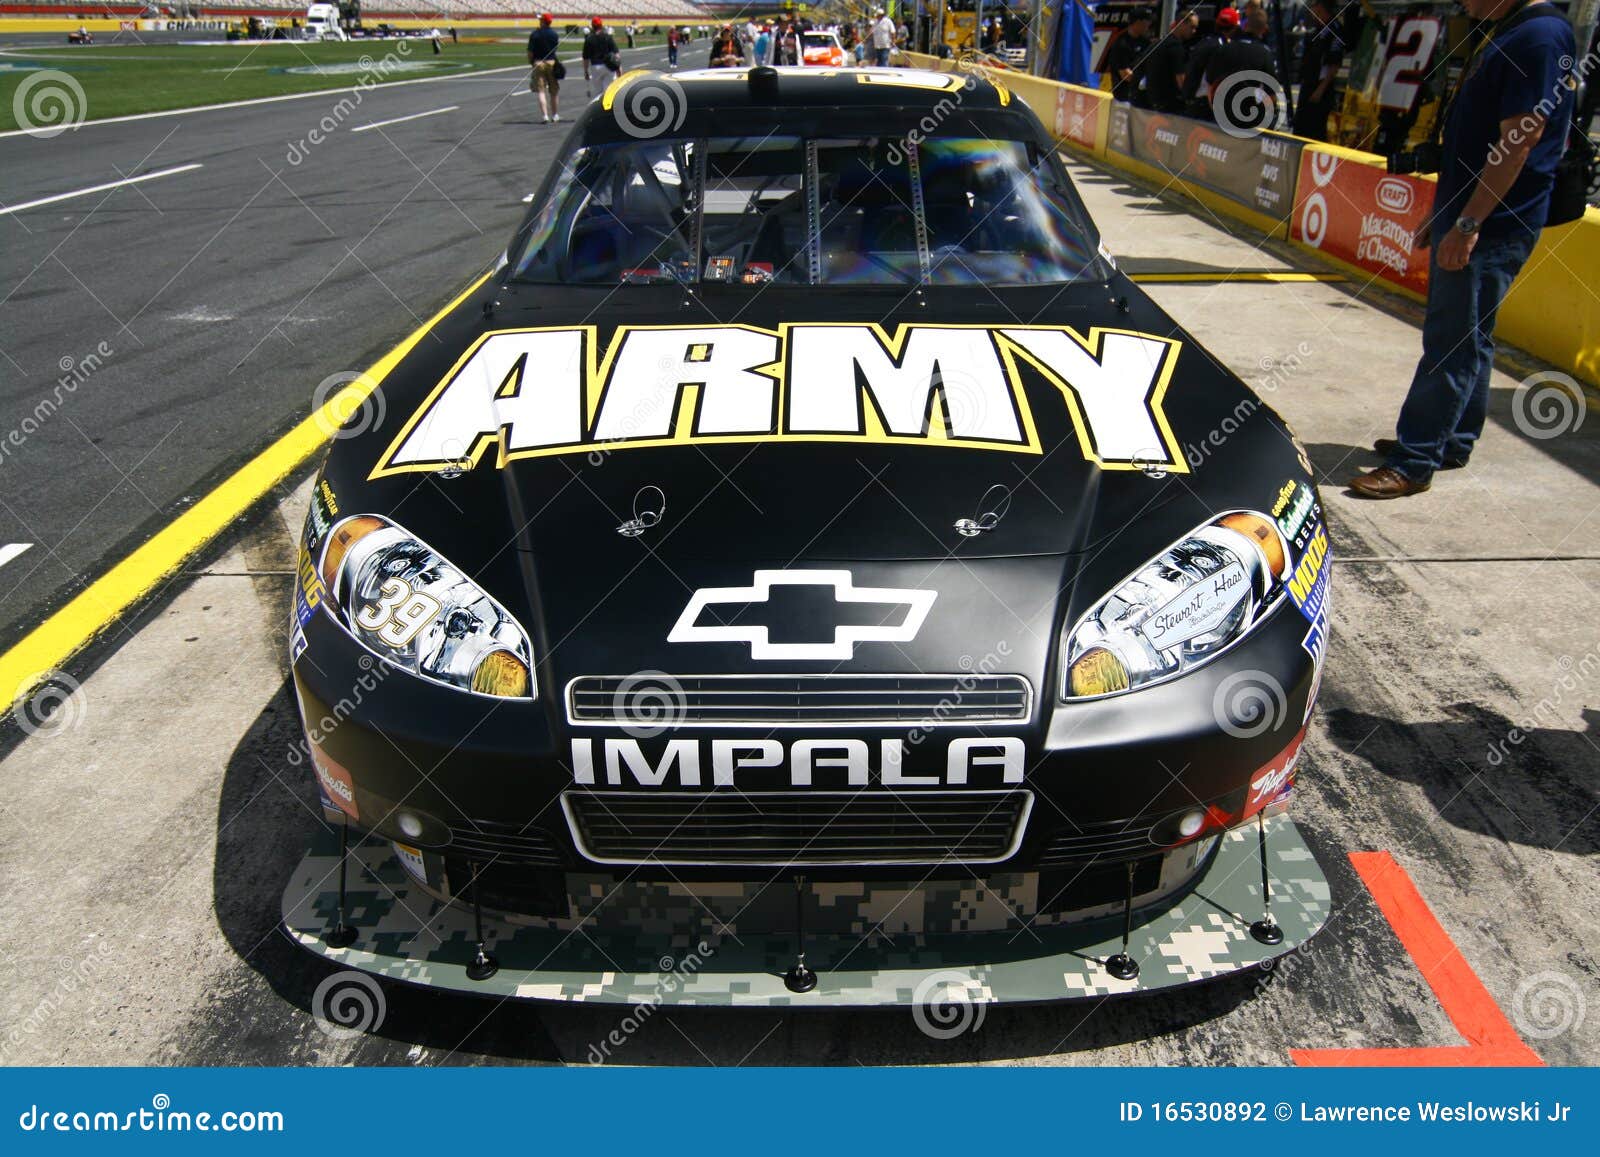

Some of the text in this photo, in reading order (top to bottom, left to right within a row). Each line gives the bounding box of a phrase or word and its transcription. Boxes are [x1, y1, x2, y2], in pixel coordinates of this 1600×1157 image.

[166, 21, 230, 31] CHARLOTT
[1154, 128, 1179, 147] PENSKE
[1198, 142, 1229, 164] PENSKE
[1360, 212, 1414, 256] Macaroni
[1366, 236, 1408, 277] Cheese
[368, 322, 1188, 480] ARMY
[1271, 479, 1297, 518] GOODYEAR
[1295, 503, 1321, 550] BELTS
[296, 546, 326, 609] OOG
[1288, 524, 1328, 609] MOOG
[356, 576, 442, 648] 39
[1153, 570, 1243, 639] Stewart Haas
[571, 737, 1025, 786] IMPALA
